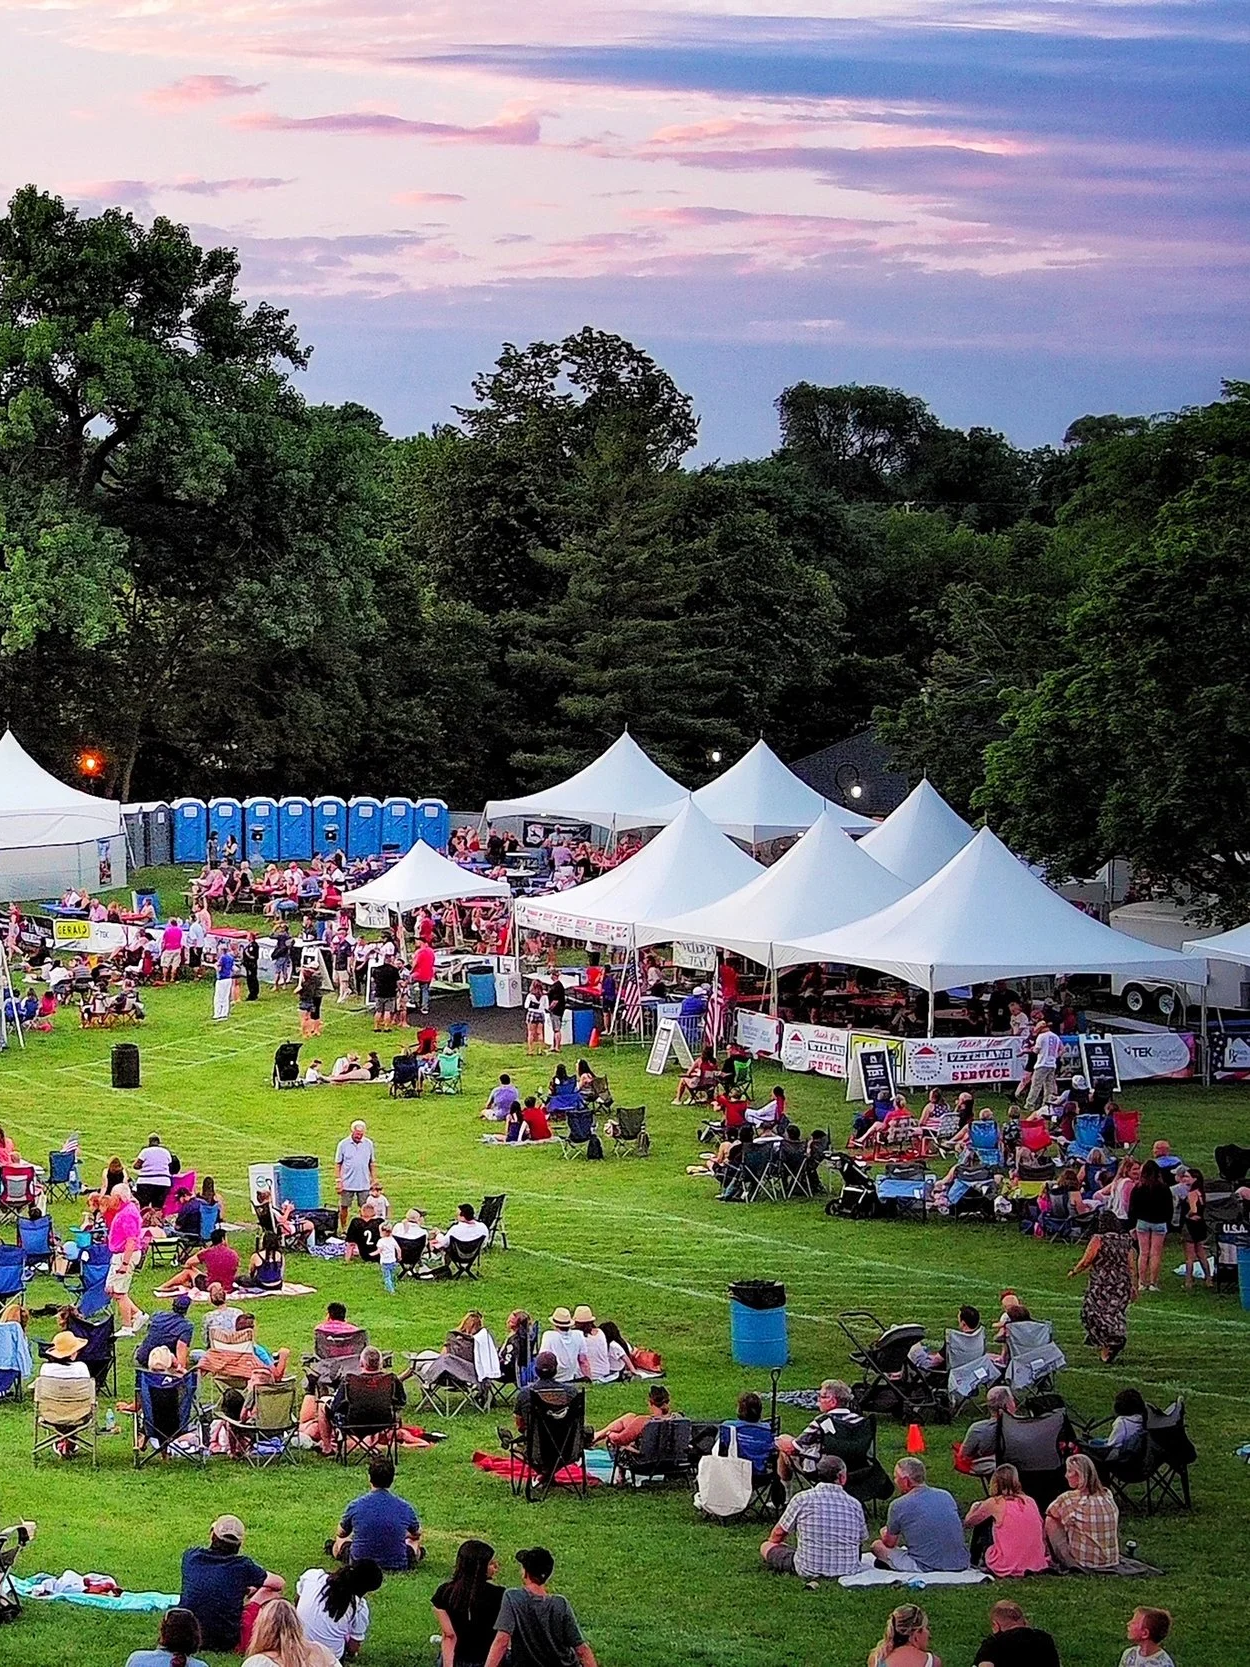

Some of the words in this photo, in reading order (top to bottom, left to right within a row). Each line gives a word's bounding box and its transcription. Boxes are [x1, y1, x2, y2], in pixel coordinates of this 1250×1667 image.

[57, 925, 88, 936] GERALD
[949, 1049, 1011, 1062] VETERANS
[952, 1068, 1010, 1081] SERVICE
[1222, 1223, 1249, 1234] U.S.A.
[363, 1229, 375, 1246] 2
